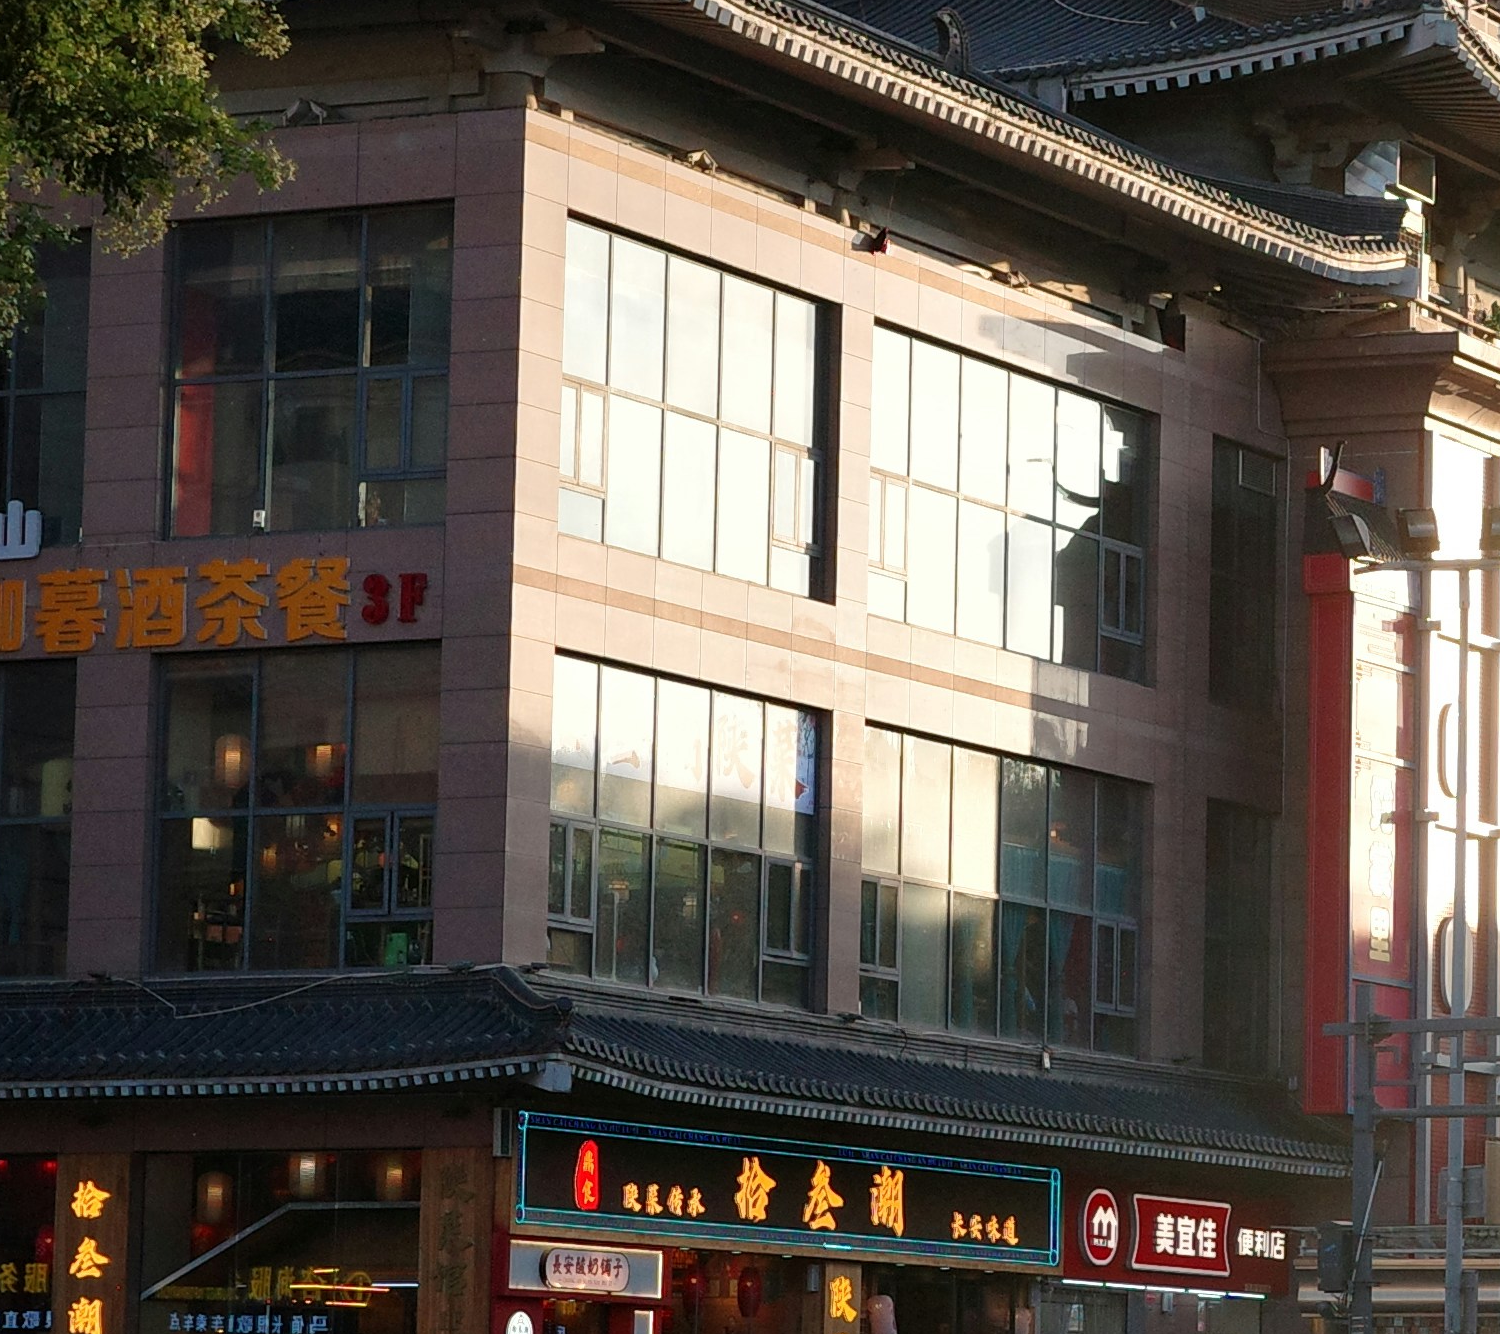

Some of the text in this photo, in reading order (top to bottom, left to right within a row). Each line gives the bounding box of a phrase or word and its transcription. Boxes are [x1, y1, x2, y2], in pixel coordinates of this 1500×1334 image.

[361, 572, 429, 625] 3F
[733, 1154, 904, 1238] 拾叁潮
[1154, 1212, 1287, 1261] 美宜佳 便利店
